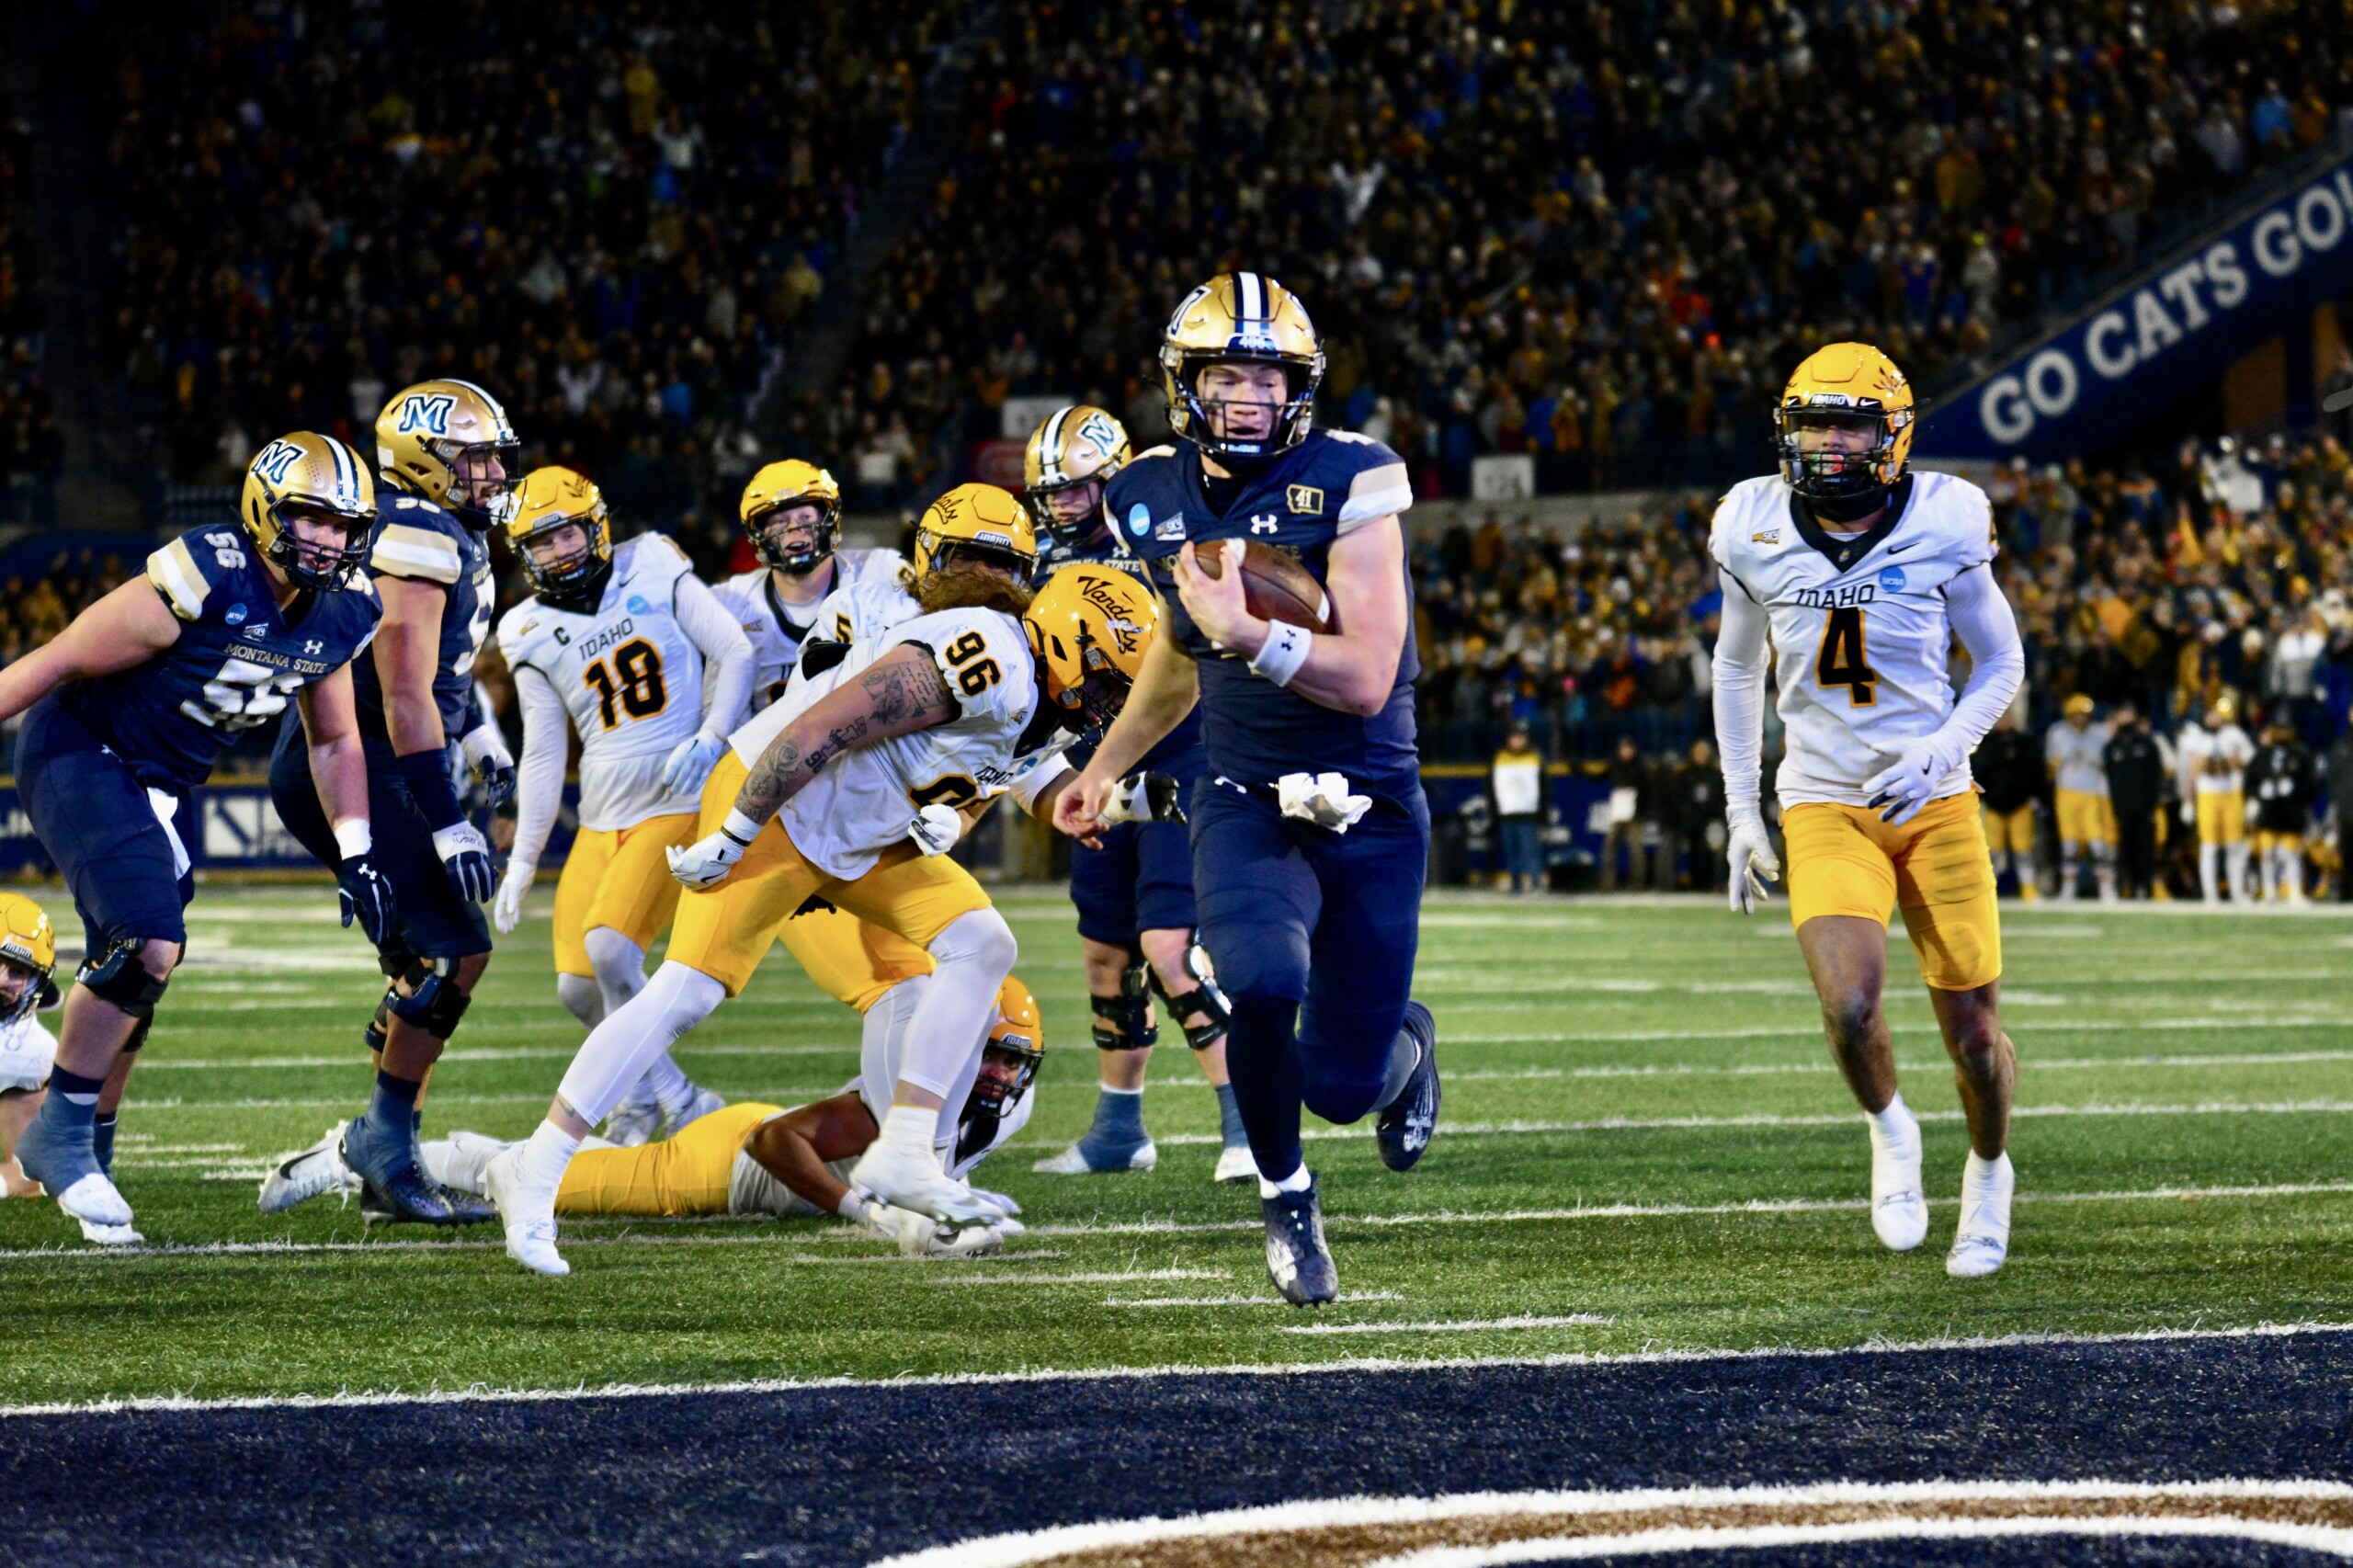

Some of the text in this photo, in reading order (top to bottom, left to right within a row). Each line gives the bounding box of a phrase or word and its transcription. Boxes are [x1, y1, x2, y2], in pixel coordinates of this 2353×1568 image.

[1979, 347, 2079, 445] GO
[2084, 241, 2250, 381] CATS
[396, 392, 459, 435] M
[1811, 394, 1847, 405] IDAHO
[254, 439, 308, 485] M
[1294, 489, 1313, 508] 41
[203, 532, 246, 569] 56
[1103, 559, 1141, 573] STATE
[1077, 575, 1147, 655] Vandals
[1796, 584, 1877, 608] IDAHO
[553, 626, 571, 646] C
[578, 618, 634, 661] IDAHO
[223, 642, 328, 675] MONTANA STATE
[944, 630, 1003, 699] 96
[1816, 607, 1879, 709] 4
[179, 658, 305, 733] 56
[582, 636, 669, 733] 18
[1006, 1035, 1031, 1048] IDAHO
